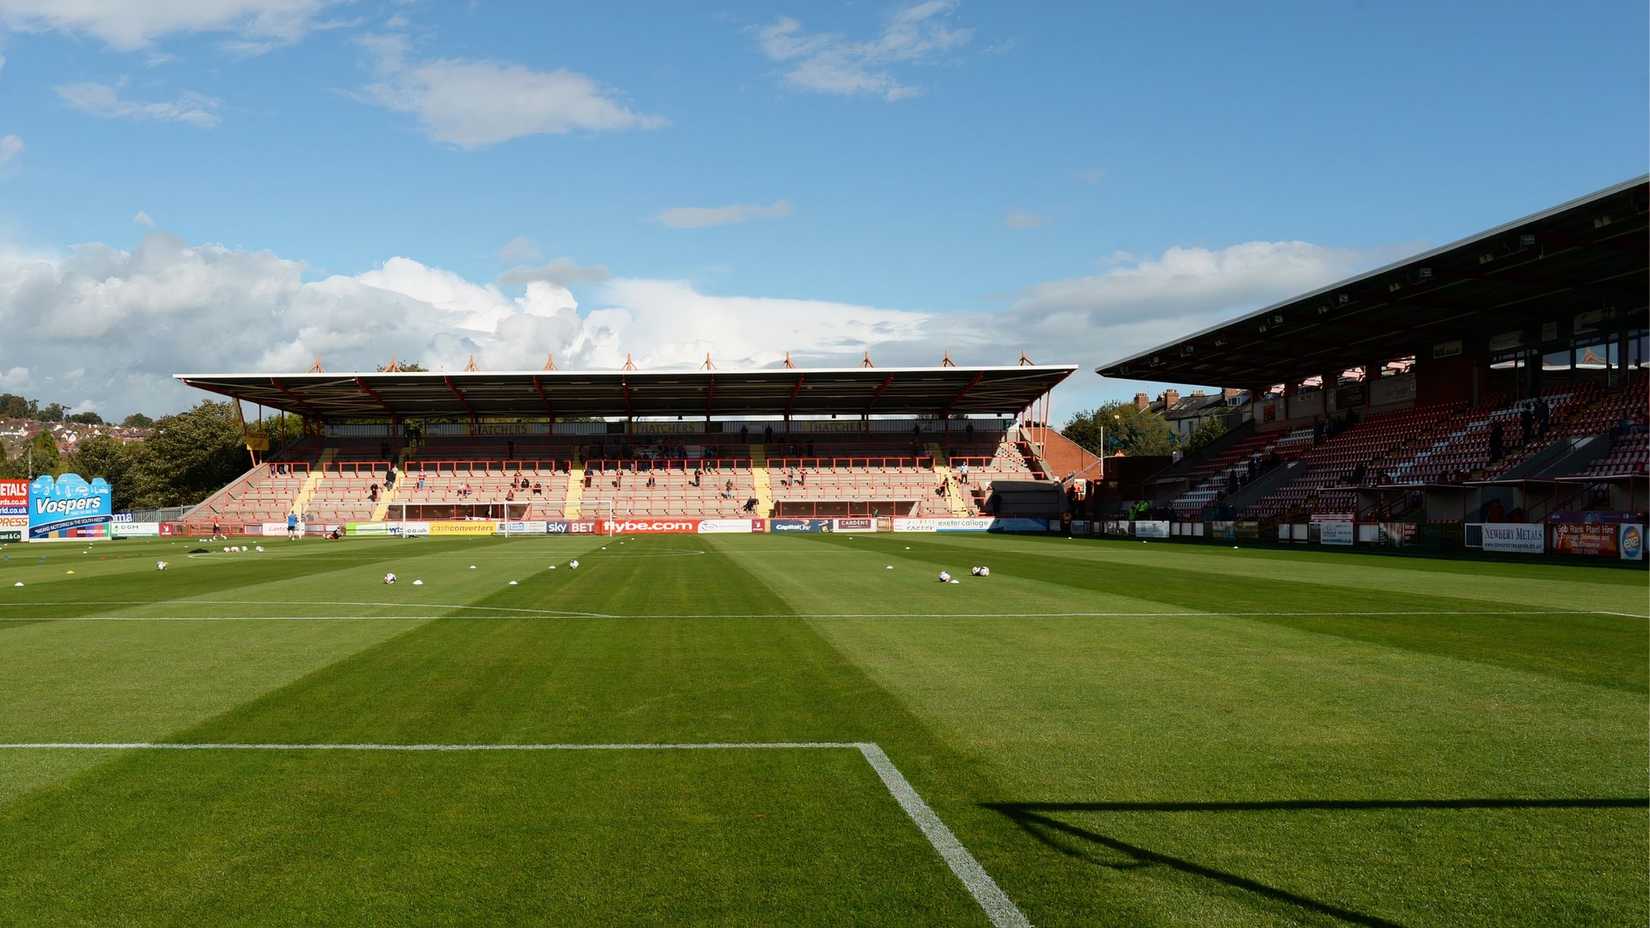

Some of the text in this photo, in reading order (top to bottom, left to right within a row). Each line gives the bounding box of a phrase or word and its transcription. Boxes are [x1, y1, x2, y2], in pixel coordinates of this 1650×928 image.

[36, 496, 102, 515] Vospers
[548, 522, 594, 532] sky BET
[604, 521, 693, 532] flybe.com
